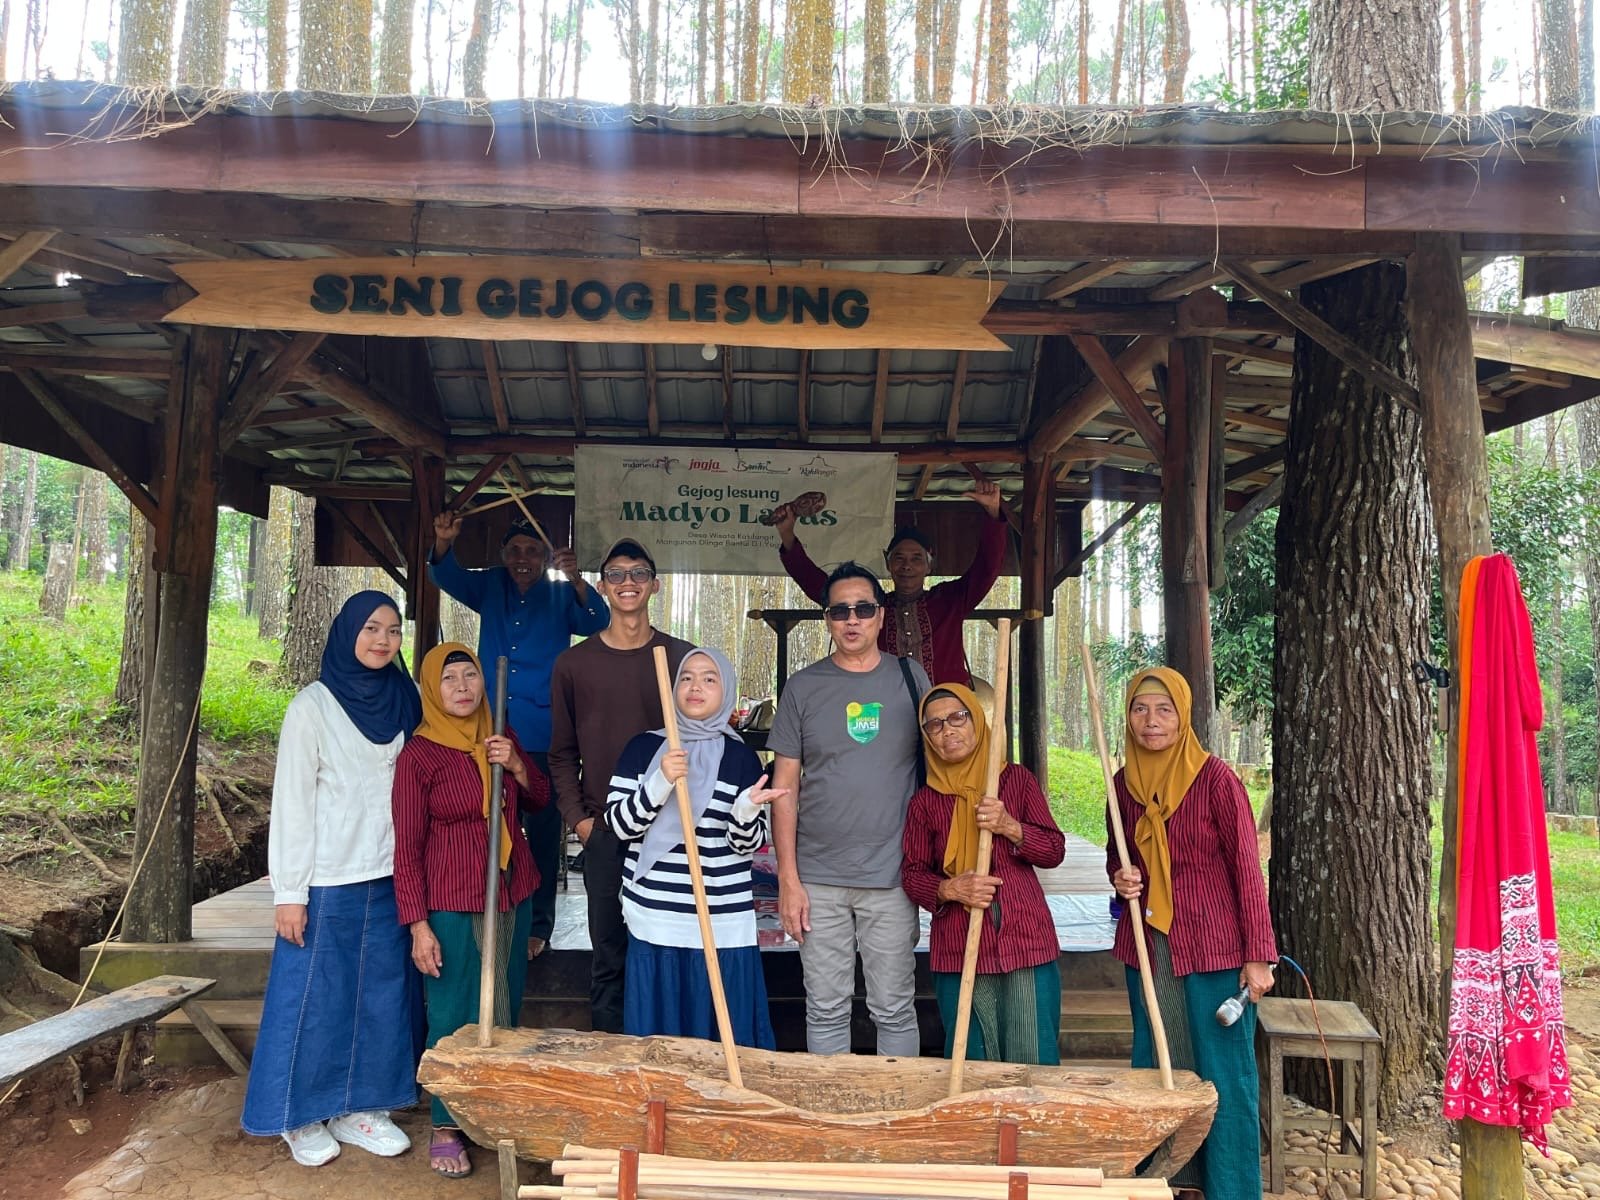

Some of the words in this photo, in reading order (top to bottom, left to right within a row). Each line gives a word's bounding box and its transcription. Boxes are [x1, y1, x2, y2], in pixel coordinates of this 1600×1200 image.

[310, 274, 463, 317] SENI
[476, 278, 653, 321] GEJOG
[668, 283, 870, 329] LESUNG
[688, 459, 720, 471] jogja
[678, 484, 724, 500] Gejog
[727, 485, 780, 502] lesung
[619, 501, 731, 529] Madyo
[739, 504, 838, 527] Laas
[688, 531, 708, 539] Desa
[709, 531, 736, 540] Wisata
[853, 720, 879, 729] JMSI
